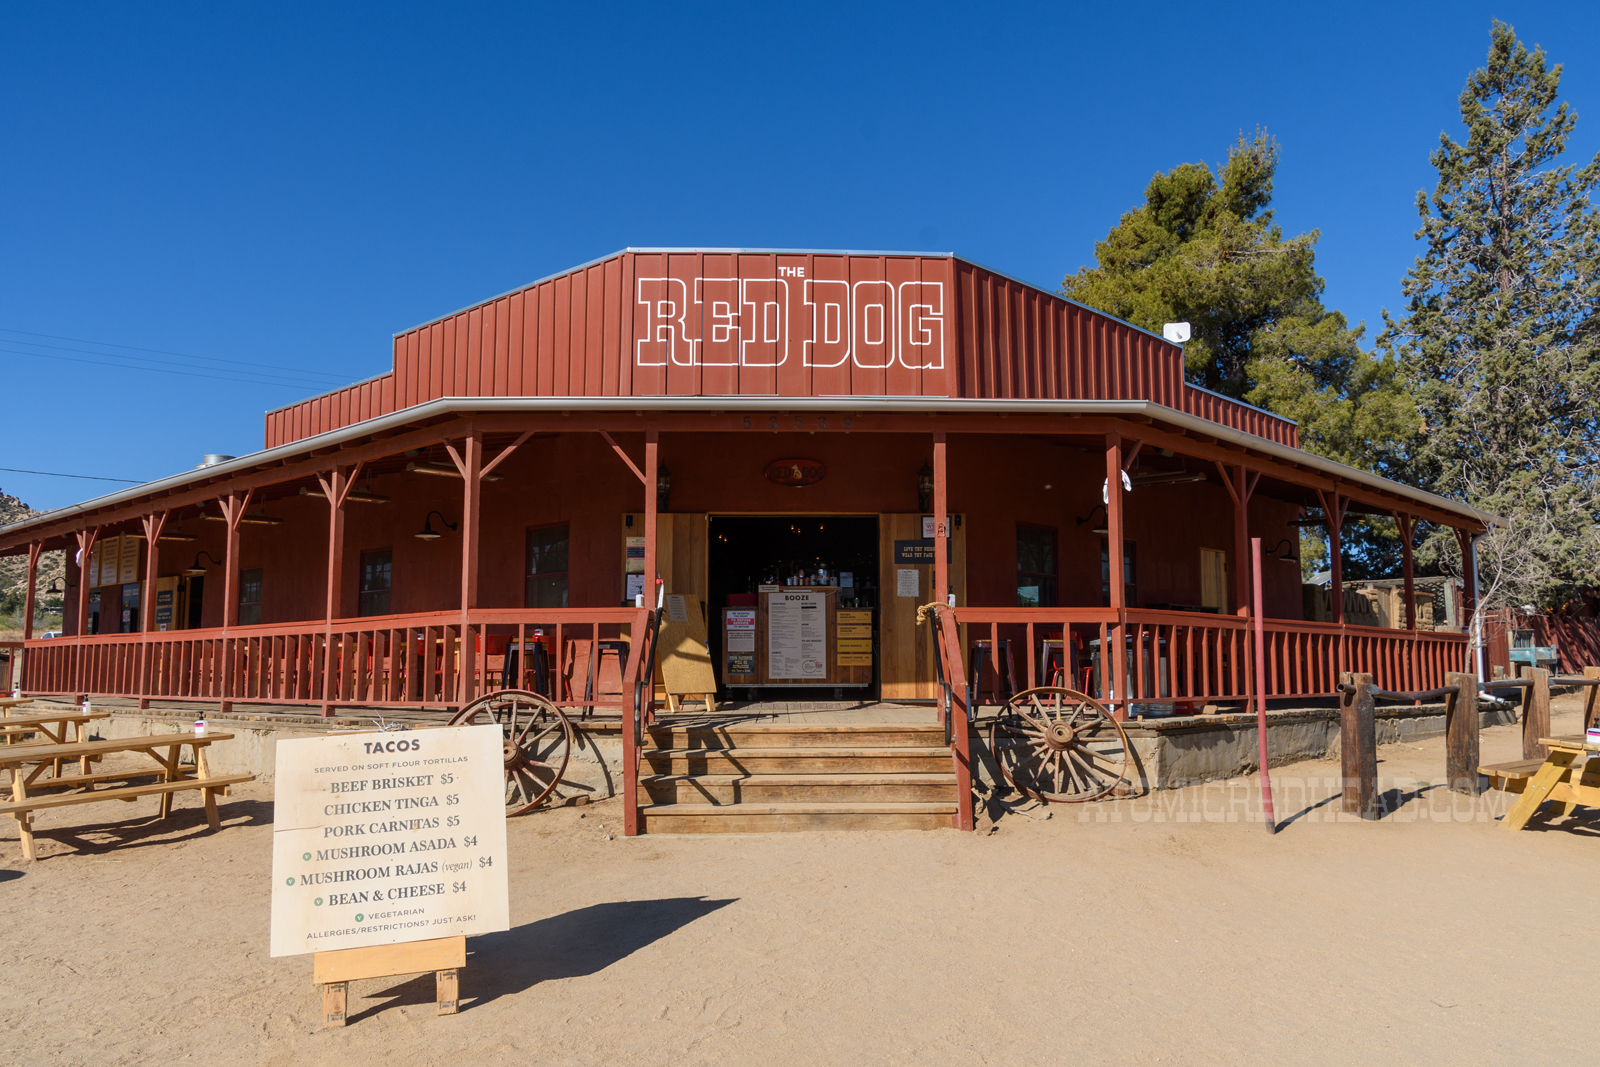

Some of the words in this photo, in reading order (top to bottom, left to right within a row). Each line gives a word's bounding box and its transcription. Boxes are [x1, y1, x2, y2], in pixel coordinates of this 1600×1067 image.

[778, 266, 805, 278] THE
[638, 278, 789, 367] RED
[804, 280, 944, 369] DOG
[770, 466, 791, 478] RED
[802, 466, 823, 479] DOG
[364, 739, 420, 754] TACOS
[423, 756, 468, 766] TORTILLAS
[330, 780, 368, 793] BEEF
[372, 775, 433, 790] BRISKET
[441, 773, 454, 785] $5
[324, 800, 391, 815] CHICKEN
[395, 796, 439, 810] TINGA
[446, 794, 459, 806] $5
[324, 824, 365, 838] PORK
[369, 818, 440, 834] CARNITAS
[447, 816, 460, 827] $5
[316, 842, 405, 861] MUSHROOM
[410, 838, 456, 852] ASADA
[464, 835, 477, 848] $4
[300, 866, 390, 886] MUSHROOM
[396, 862, 438, 876] RAJAS
[442, 860, 472, 873] (vegan)
[479, 856, 492, 868] $4
[329, 891, 369, 906] BEAN
[372, 890, 384, 901] &
[388, 883, 445, 899] CHEESE
[453, 881, 466, 893] $4
[368, 908, 424, 920] VEGETARIAN
[307, 920, 429, 939] ALLERGIES/RESTRICTIONS?
[432, 917, 452, 925] JUST
